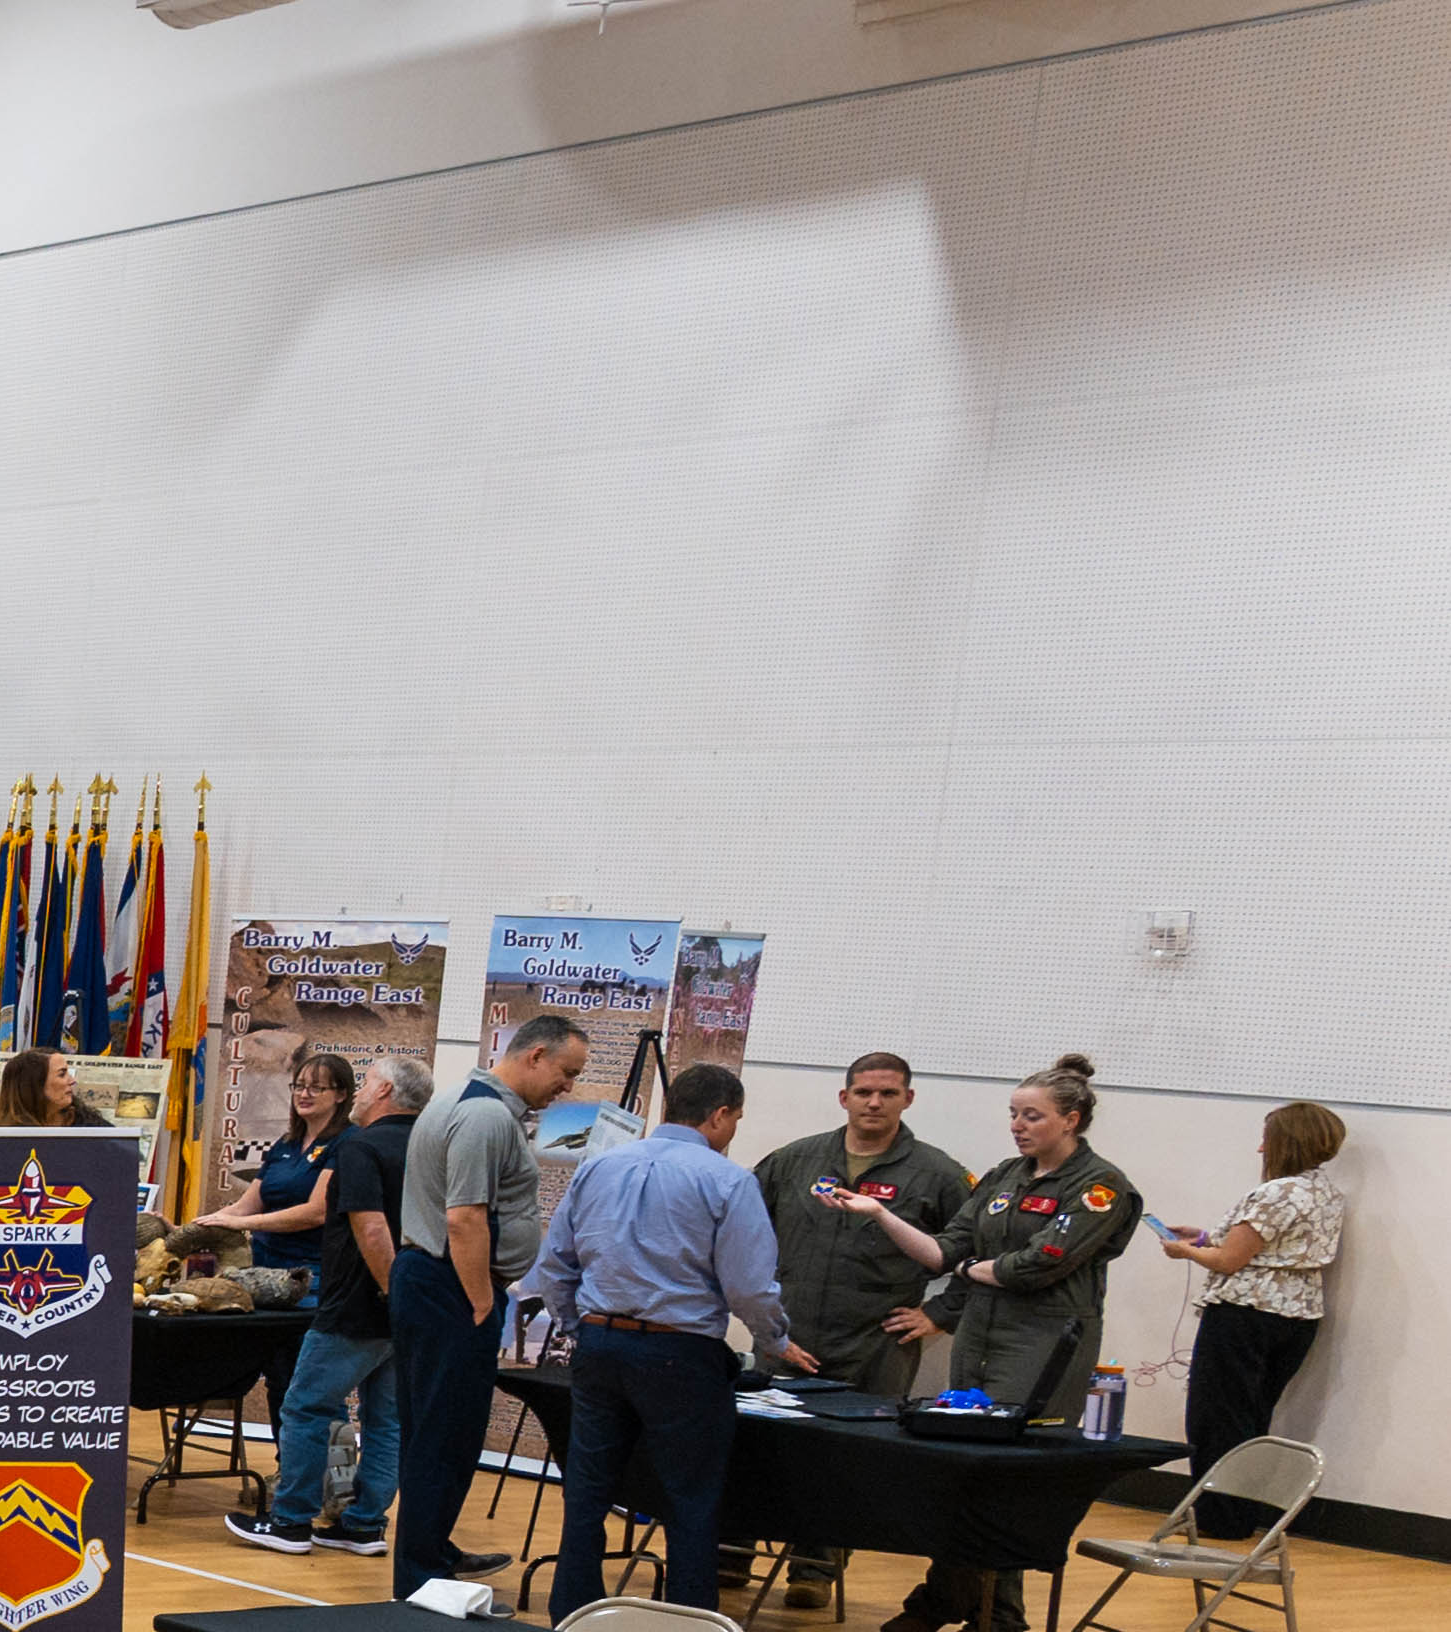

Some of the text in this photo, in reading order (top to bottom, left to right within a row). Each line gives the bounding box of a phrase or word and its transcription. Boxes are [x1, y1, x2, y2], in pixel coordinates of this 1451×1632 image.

[244, 930, 338, 951] Barry M.
[503, 929, 583, 952] Barry M.
[268, 956, 384, 976] Goldwater
[523, 957, 621, 980] Goldwater
[296, 983, 424, 1006] Range East
[542, 985, 653, 1012] Range East
[314, 1043, 372, 1054] Prehistoric
[375, 1043, 385, 1054] &
[388, 1045, 426, 1055] historic
[218, 986, 252, 1190] CULTURAL
[3, 1226, 57, 1242] SPARK
[34, 1284, 100, 1325] COUNTRY
[17, 1405, 46, 1423] TO
[50, 1406, 125, 1424] CREATE
[61, 1431, 121, 1450] VALUE
[50, 1580, 90, 1607] WING
